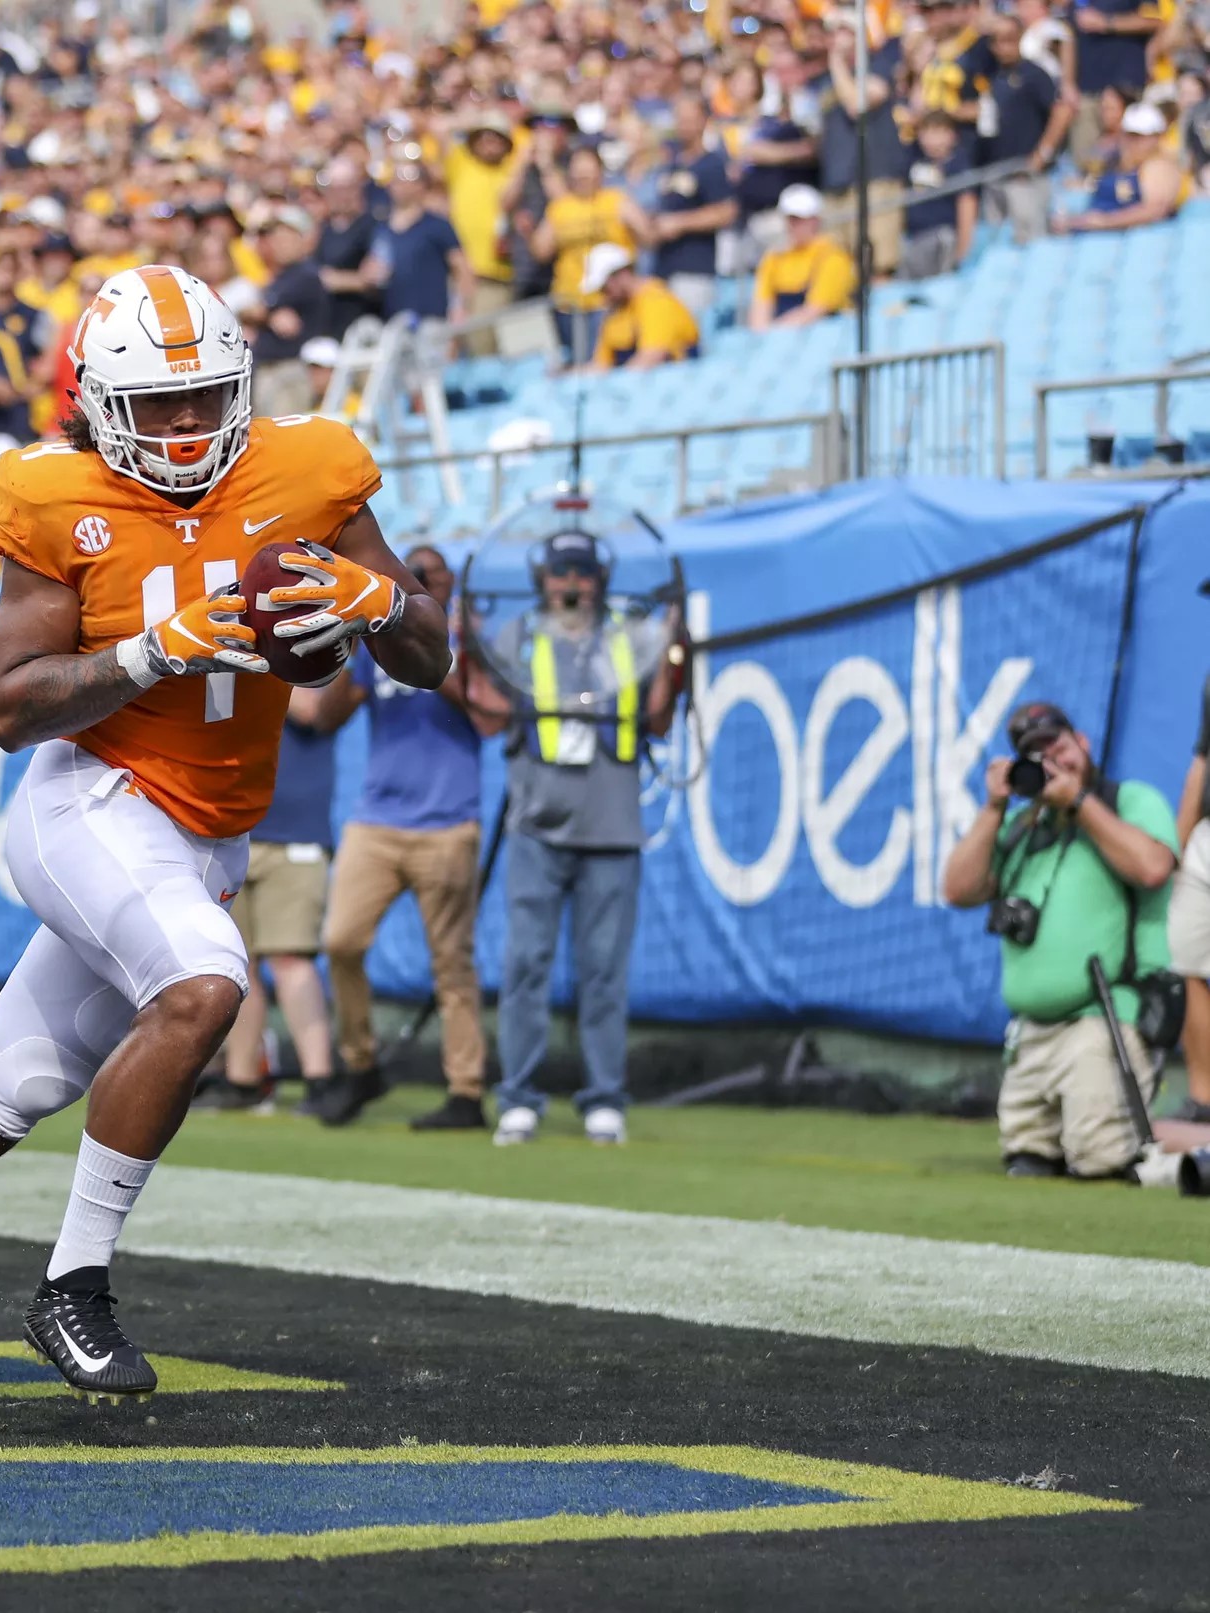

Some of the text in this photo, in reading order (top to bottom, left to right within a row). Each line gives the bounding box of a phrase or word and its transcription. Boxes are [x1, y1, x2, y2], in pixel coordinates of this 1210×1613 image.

[169, 360, 202, 374] VOLS
[74, 515, 112, 553] SEC
[175, 518, 200, 543] T
[686, 585, 1033, 908] belk
